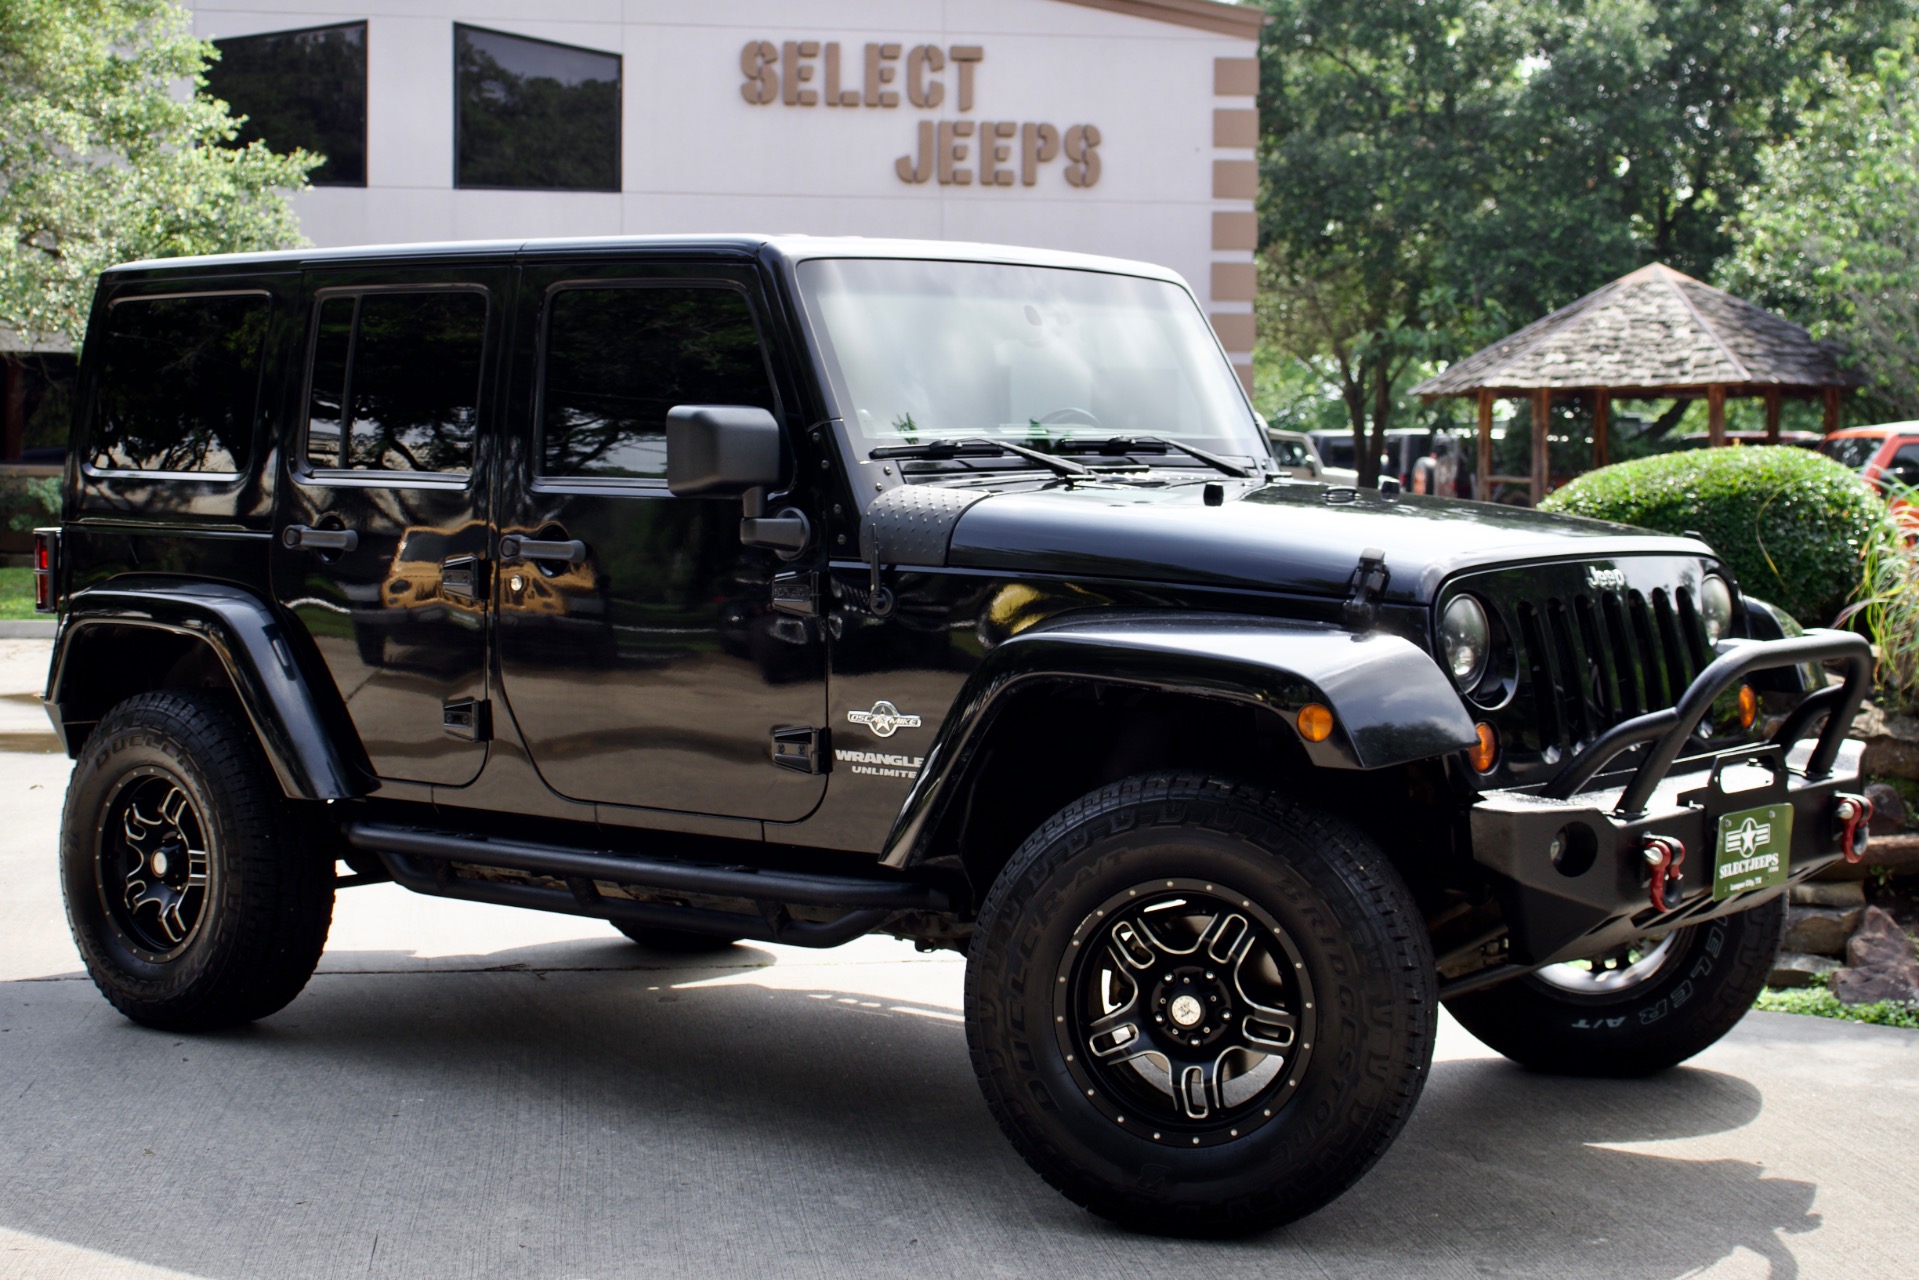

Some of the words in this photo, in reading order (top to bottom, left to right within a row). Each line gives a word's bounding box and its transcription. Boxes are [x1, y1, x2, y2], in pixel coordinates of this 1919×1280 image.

[740, 40, 984, 113] SELECT
[894, 120, 1102, 188] JEEPS
[1586, 565, 1625, 591] Jeep
[835, 749, 924, 767] WRANGLE
[851, 765, 917, 779] UNLIMITE
[1719, 852, 1779, 879] SELECTJEEPS
[1638, 915, 1729, 1026] ELER
[1571, 1015, 1627, 1030] A/T
